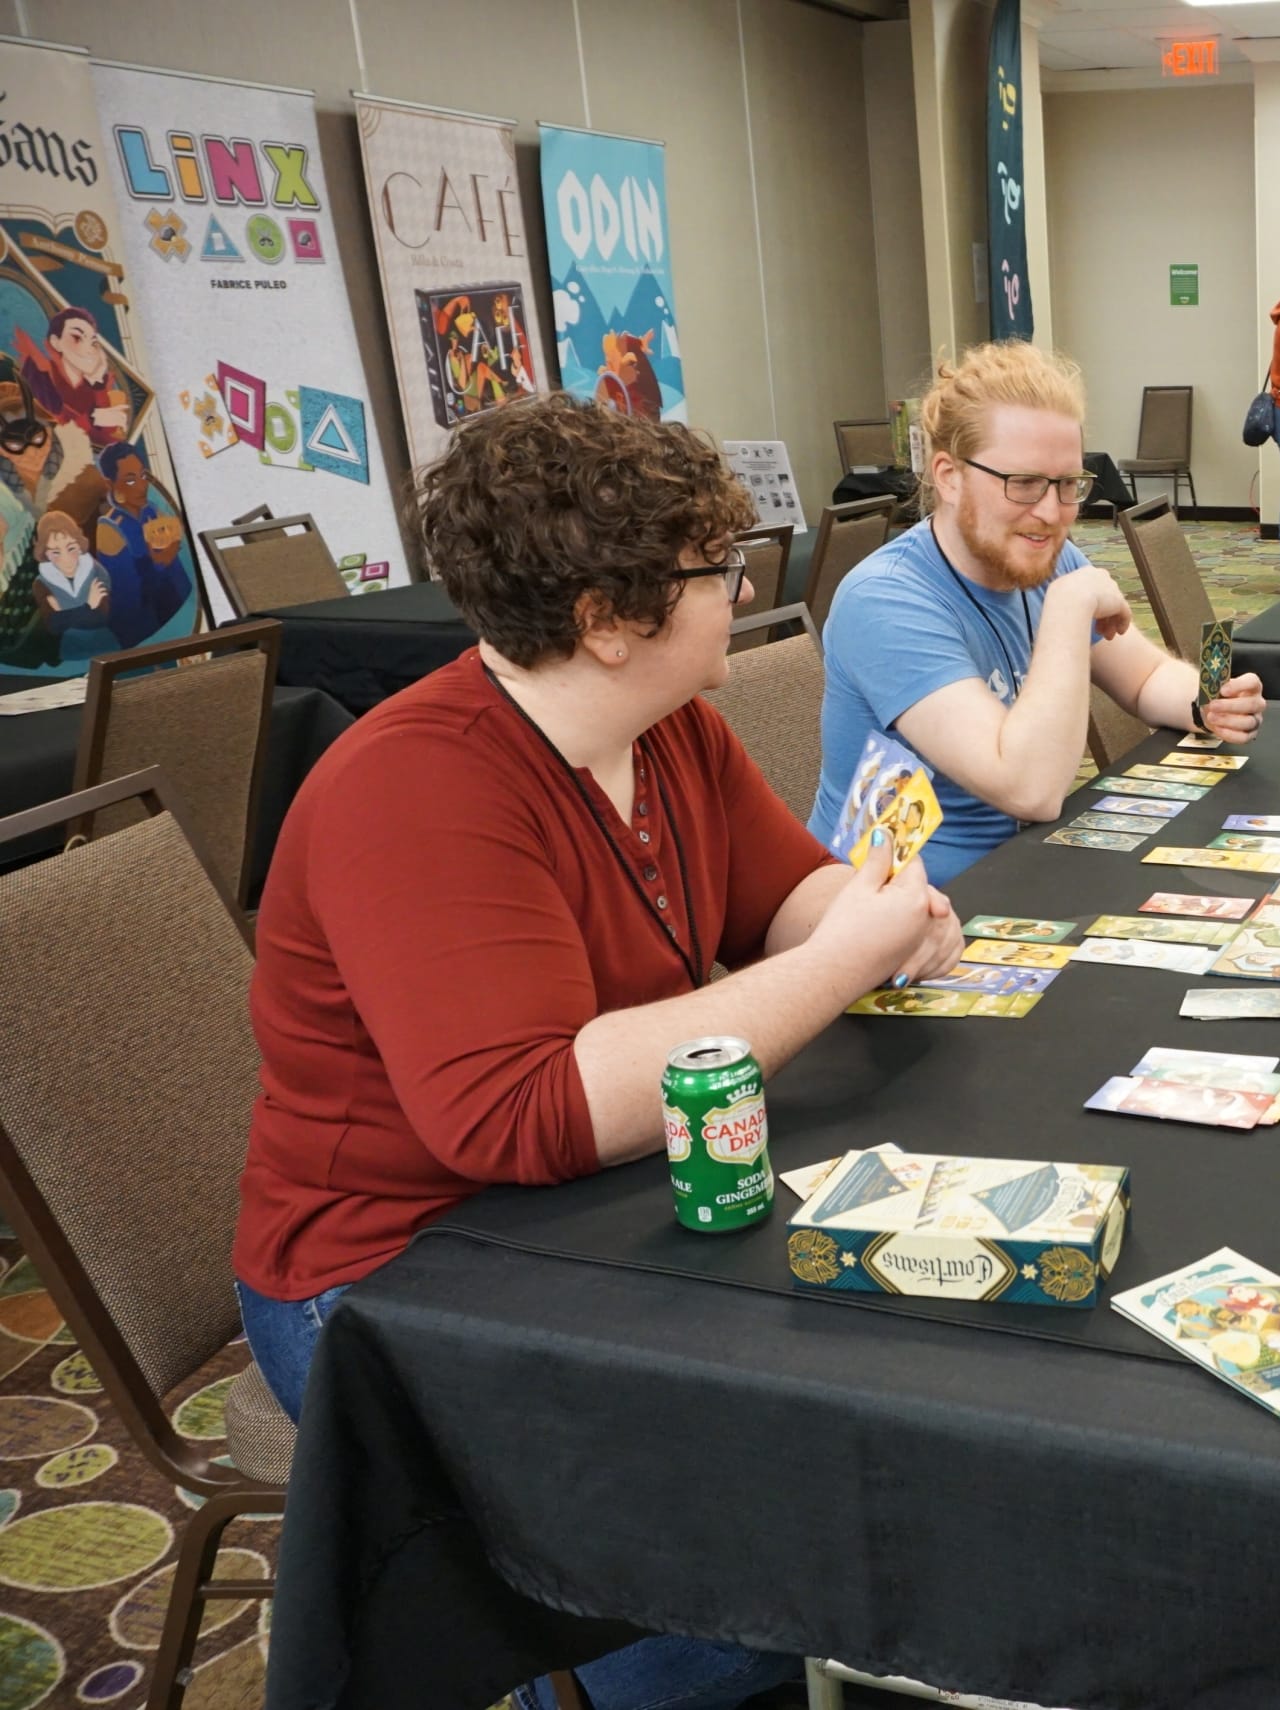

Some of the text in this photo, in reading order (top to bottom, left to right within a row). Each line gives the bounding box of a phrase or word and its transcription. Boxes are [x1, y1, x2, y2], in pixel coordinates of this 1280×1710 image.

[1172, 41, 1217, 75] EXIT
[382, 165, 525, 258] CAFÉ
[556, 169, 664, 263] ODIN
[210, 279, 287, 289] FABRICE PULEO
[703, 1108, 768, 1141] CANAD
[729, 1126, 763, 1153] DRY
[737, 1169, 766, 1190] SODA
[883, 1251, 993, 1287] Courtisans
